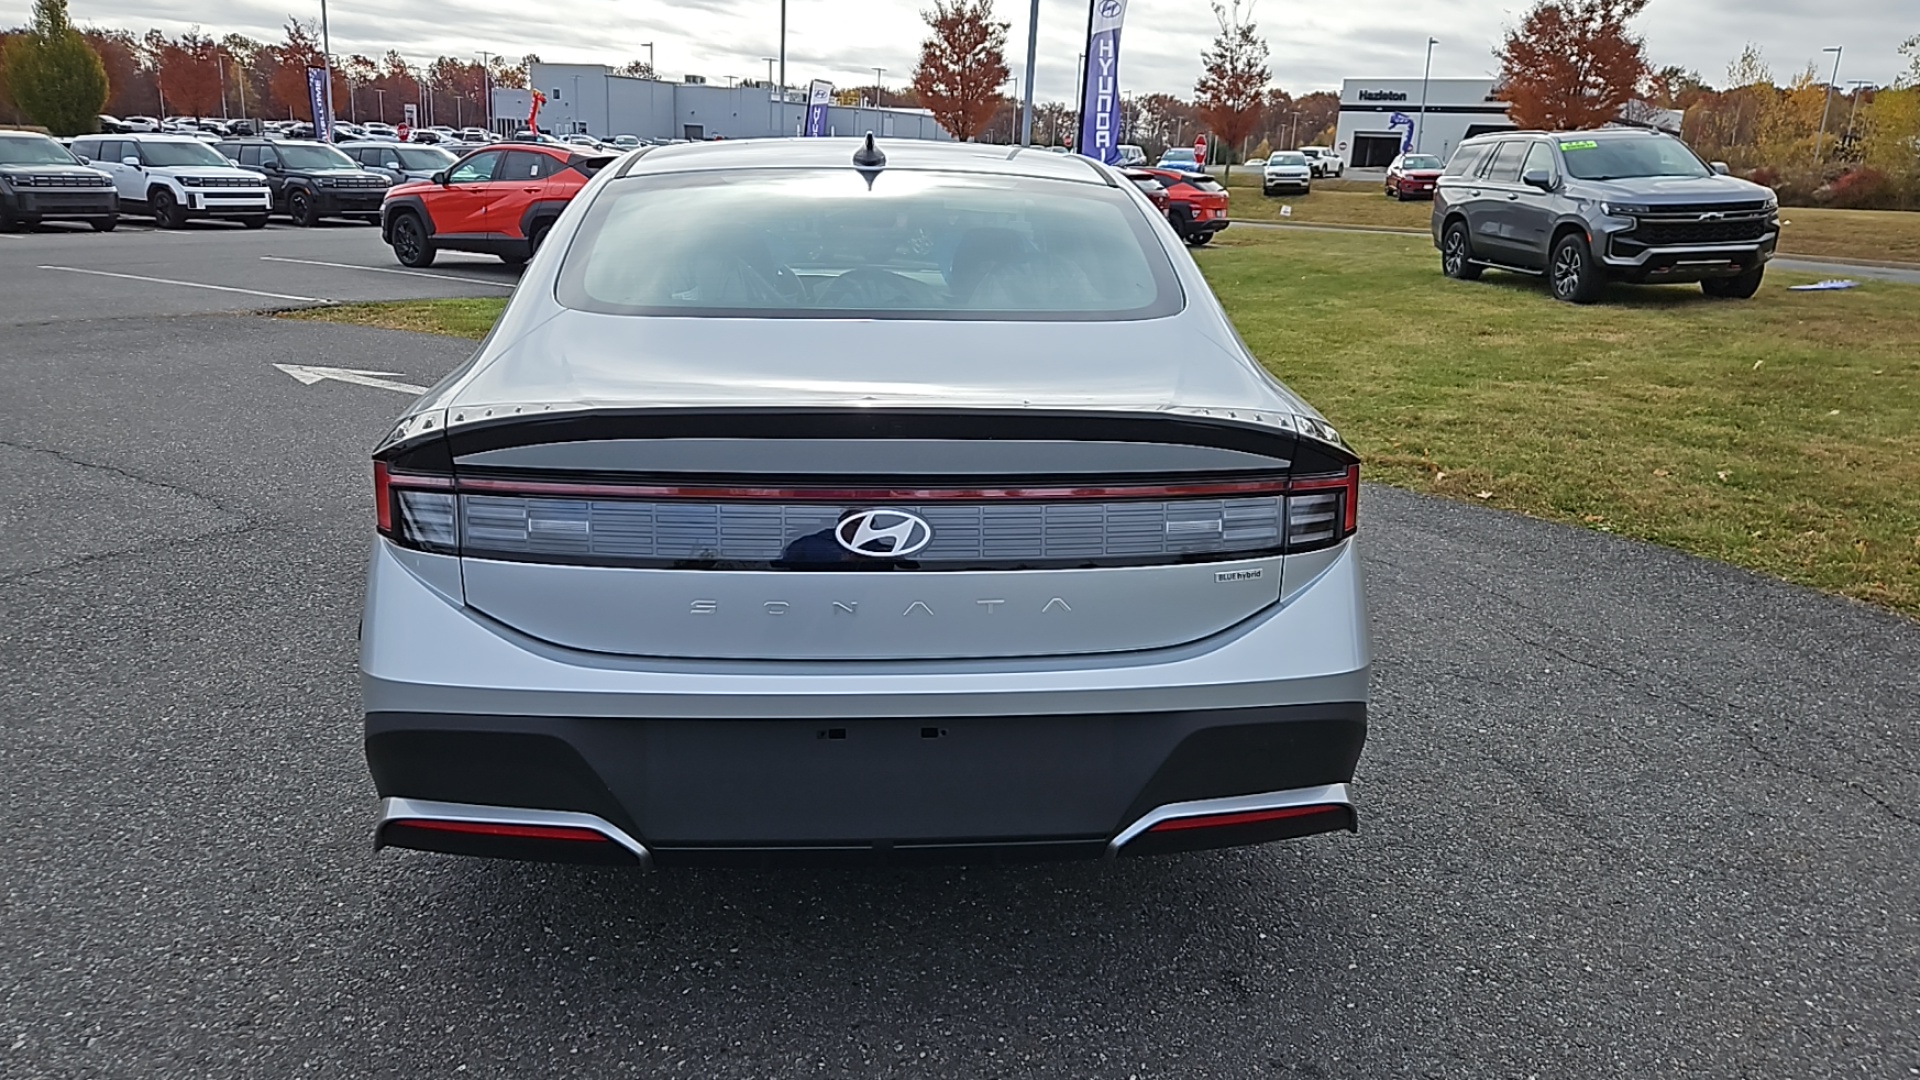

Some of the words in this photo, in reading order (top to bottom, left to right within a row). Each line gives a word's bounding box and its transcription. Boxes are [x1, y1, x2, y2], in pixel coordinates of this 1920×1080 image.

[1095, 39, 1114, 163] HYUNDAI
[1358, 89, 1407, 101] Hazleton
[1237, 570, 1261, 581] hybrid
[689, 597, 1073, 616] SONATA
